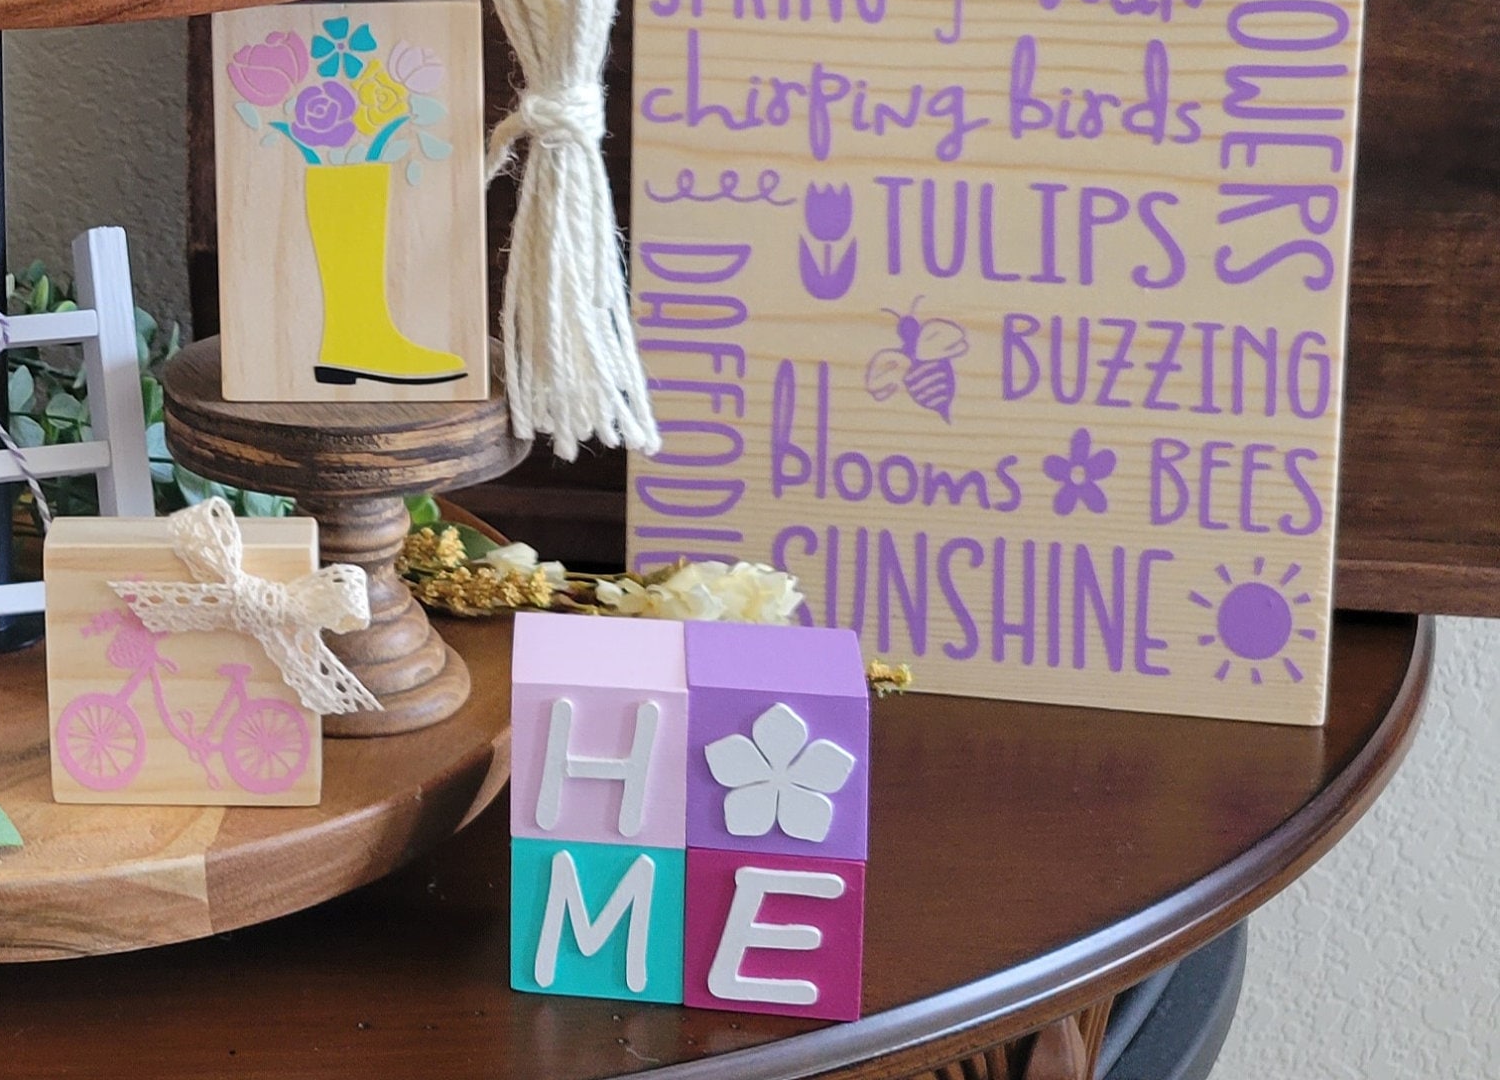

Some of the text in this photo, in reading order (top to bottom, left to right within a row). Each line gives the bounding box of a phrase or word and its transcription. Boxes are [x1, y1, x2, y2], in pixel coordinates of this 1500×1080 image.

[640, 29, 1202, 161] chirping birds
[873, 175, 1187, 291] TULIPS
[1001, 313, 1331, 420] BUZZING
[771, 358, 1023, 513] blooms
[1148, 436, 1324, 535] BEES
